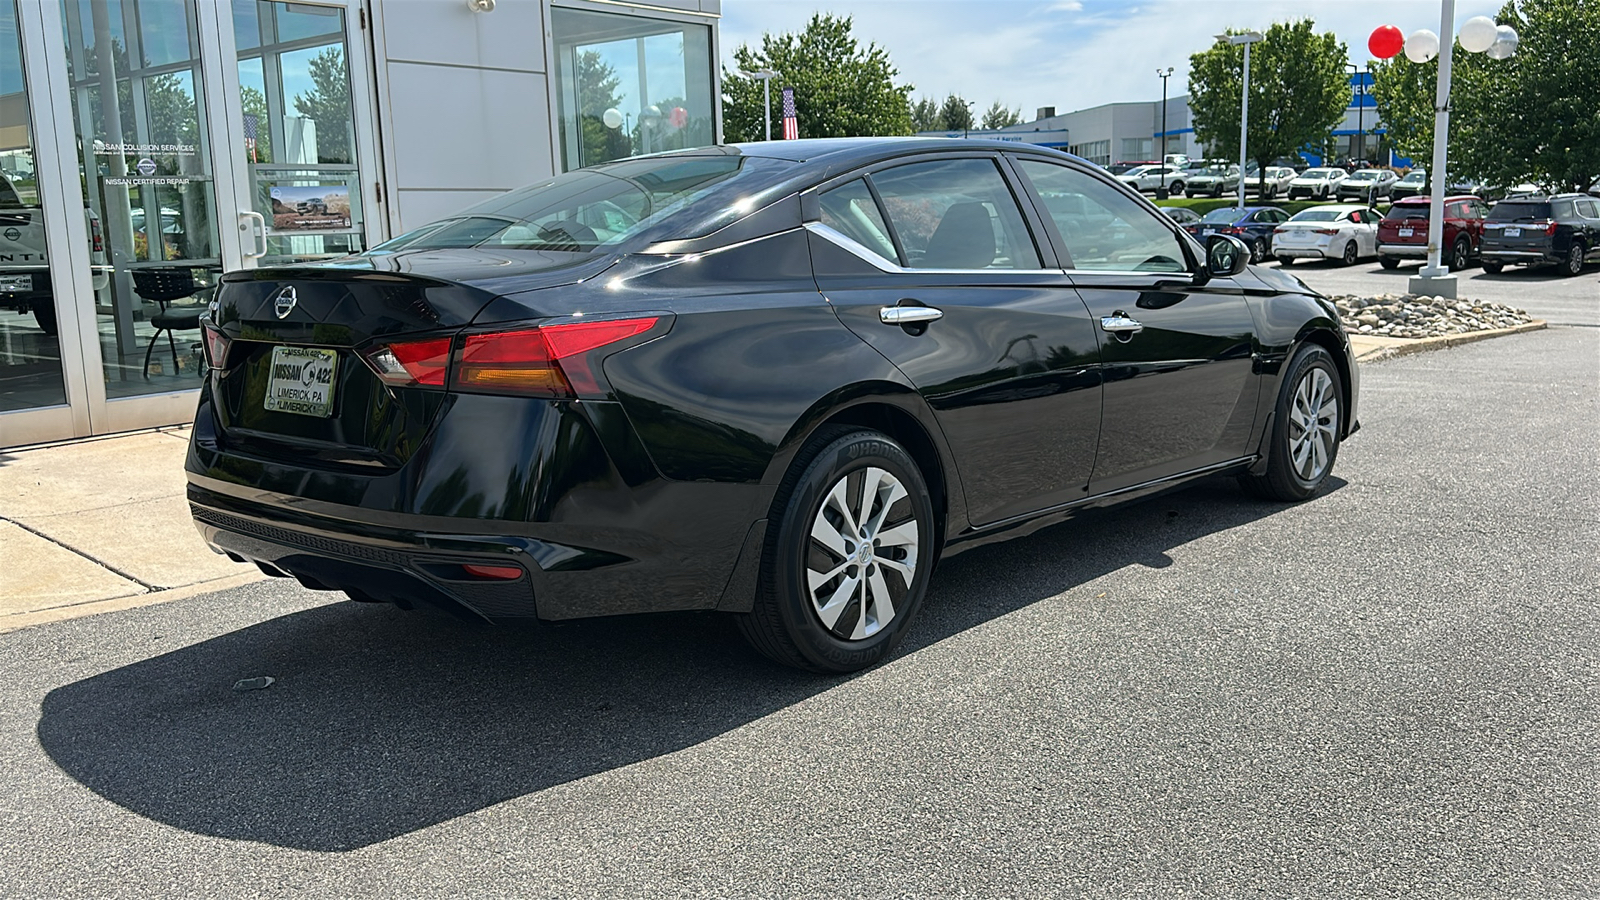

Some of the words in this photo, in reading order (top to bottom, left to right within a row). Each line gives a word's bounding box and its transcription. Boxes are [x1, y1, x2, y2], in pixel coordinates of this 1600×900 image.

[92, 143, 121, 151] NISSAN
[160, 144, 194, 152] SERVICES
[288, 349, 310, 357] NISSAN
[274, 363, 302, 381] NISSAN
[316, 367, 332, 384] 422
[277, 387, 311, 401] LIMERICK,
[312, 391, 322, 402] PA
